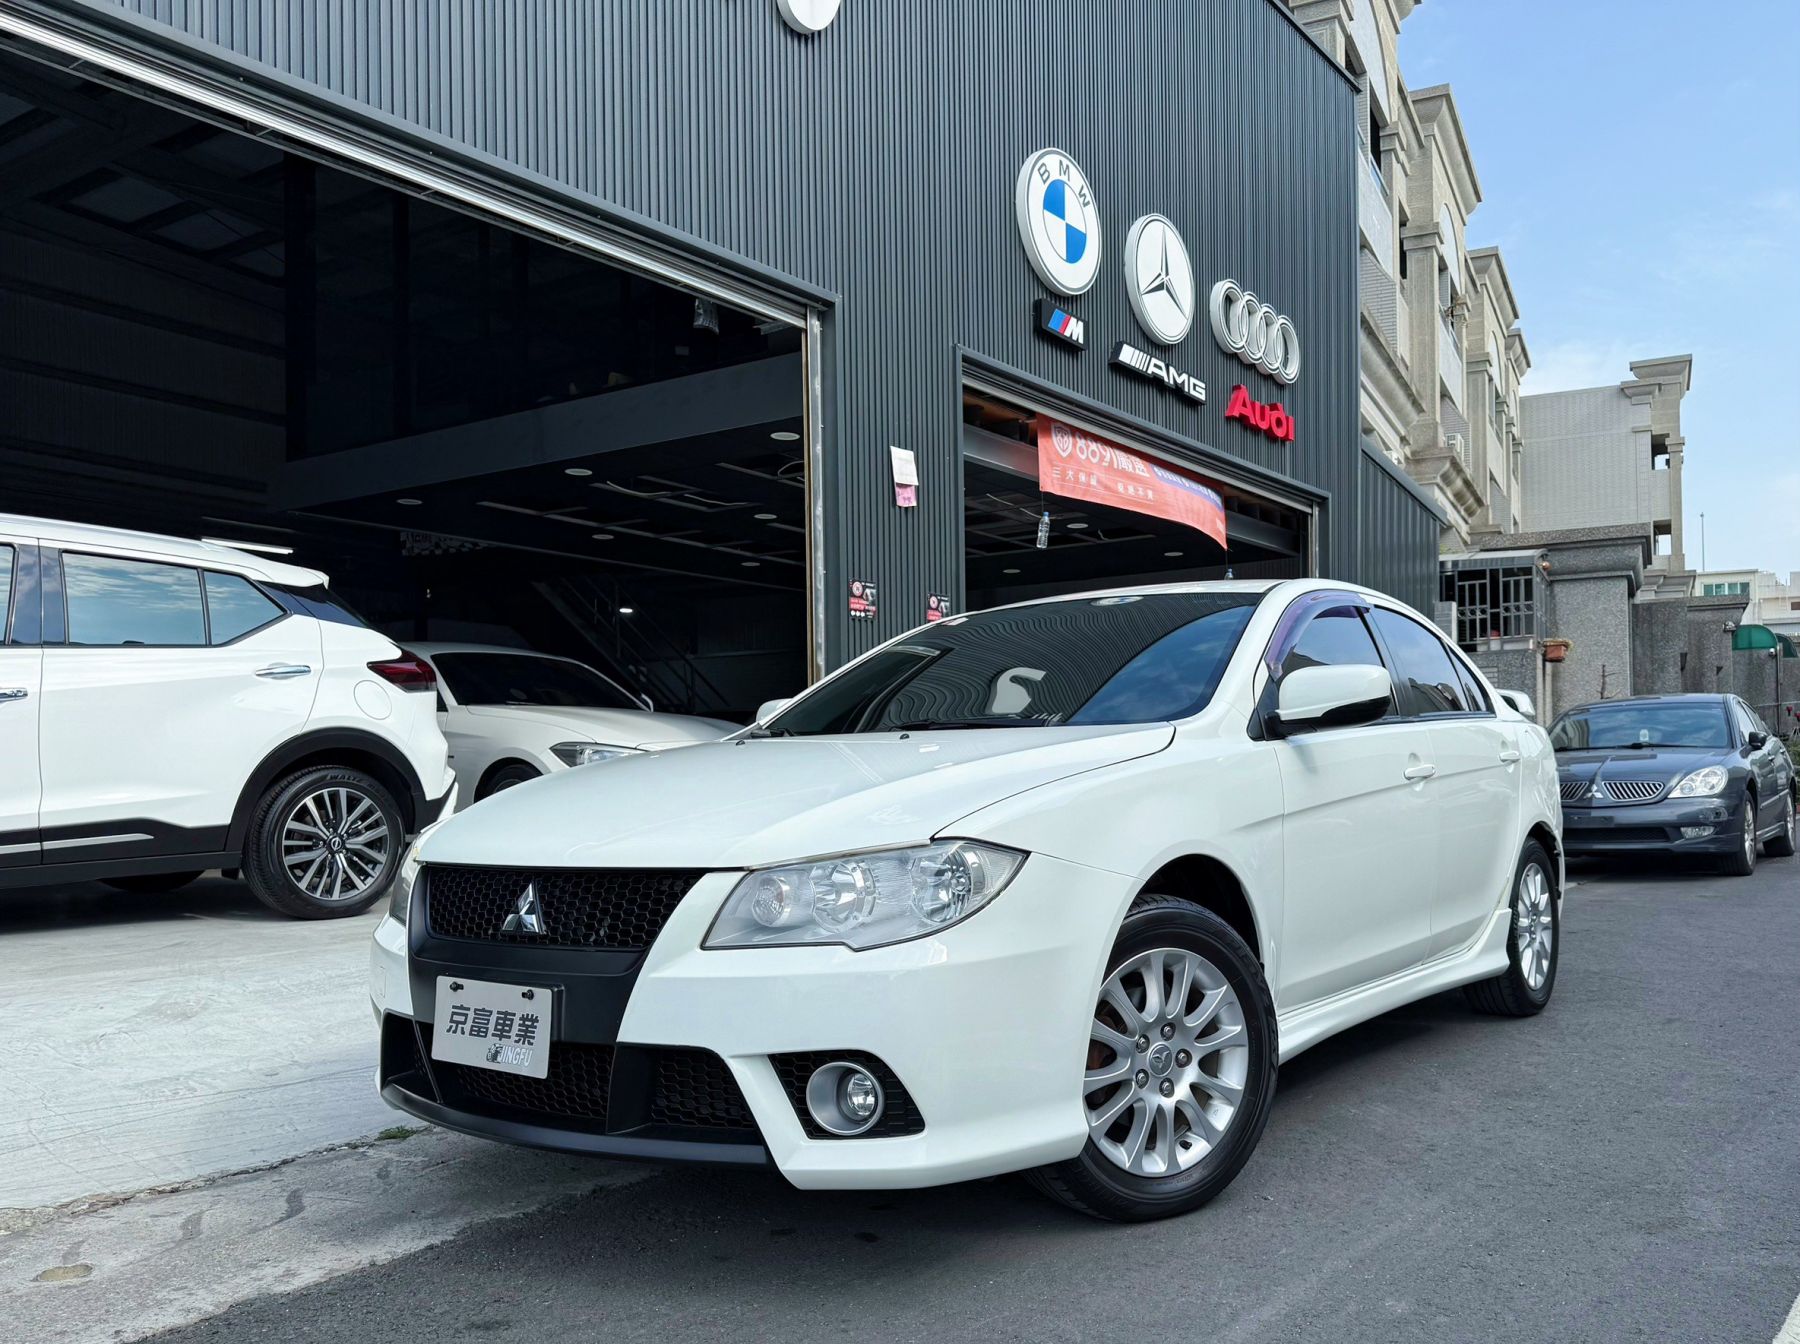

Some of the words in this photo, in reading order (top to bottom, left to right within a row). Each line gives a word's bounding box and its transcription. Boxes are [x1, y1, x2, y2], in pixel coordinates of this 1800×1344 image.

[1037, 159, 1091, 208] BMW
[1063, 316, 1084, 345] M
[1147, 356, 1206, 401] AMG
[1225, 384, 1295, 442] Audi
[446, 1004, 540, 1046] 京富車業
[498, 1045, 533, 1067] JINGFU
